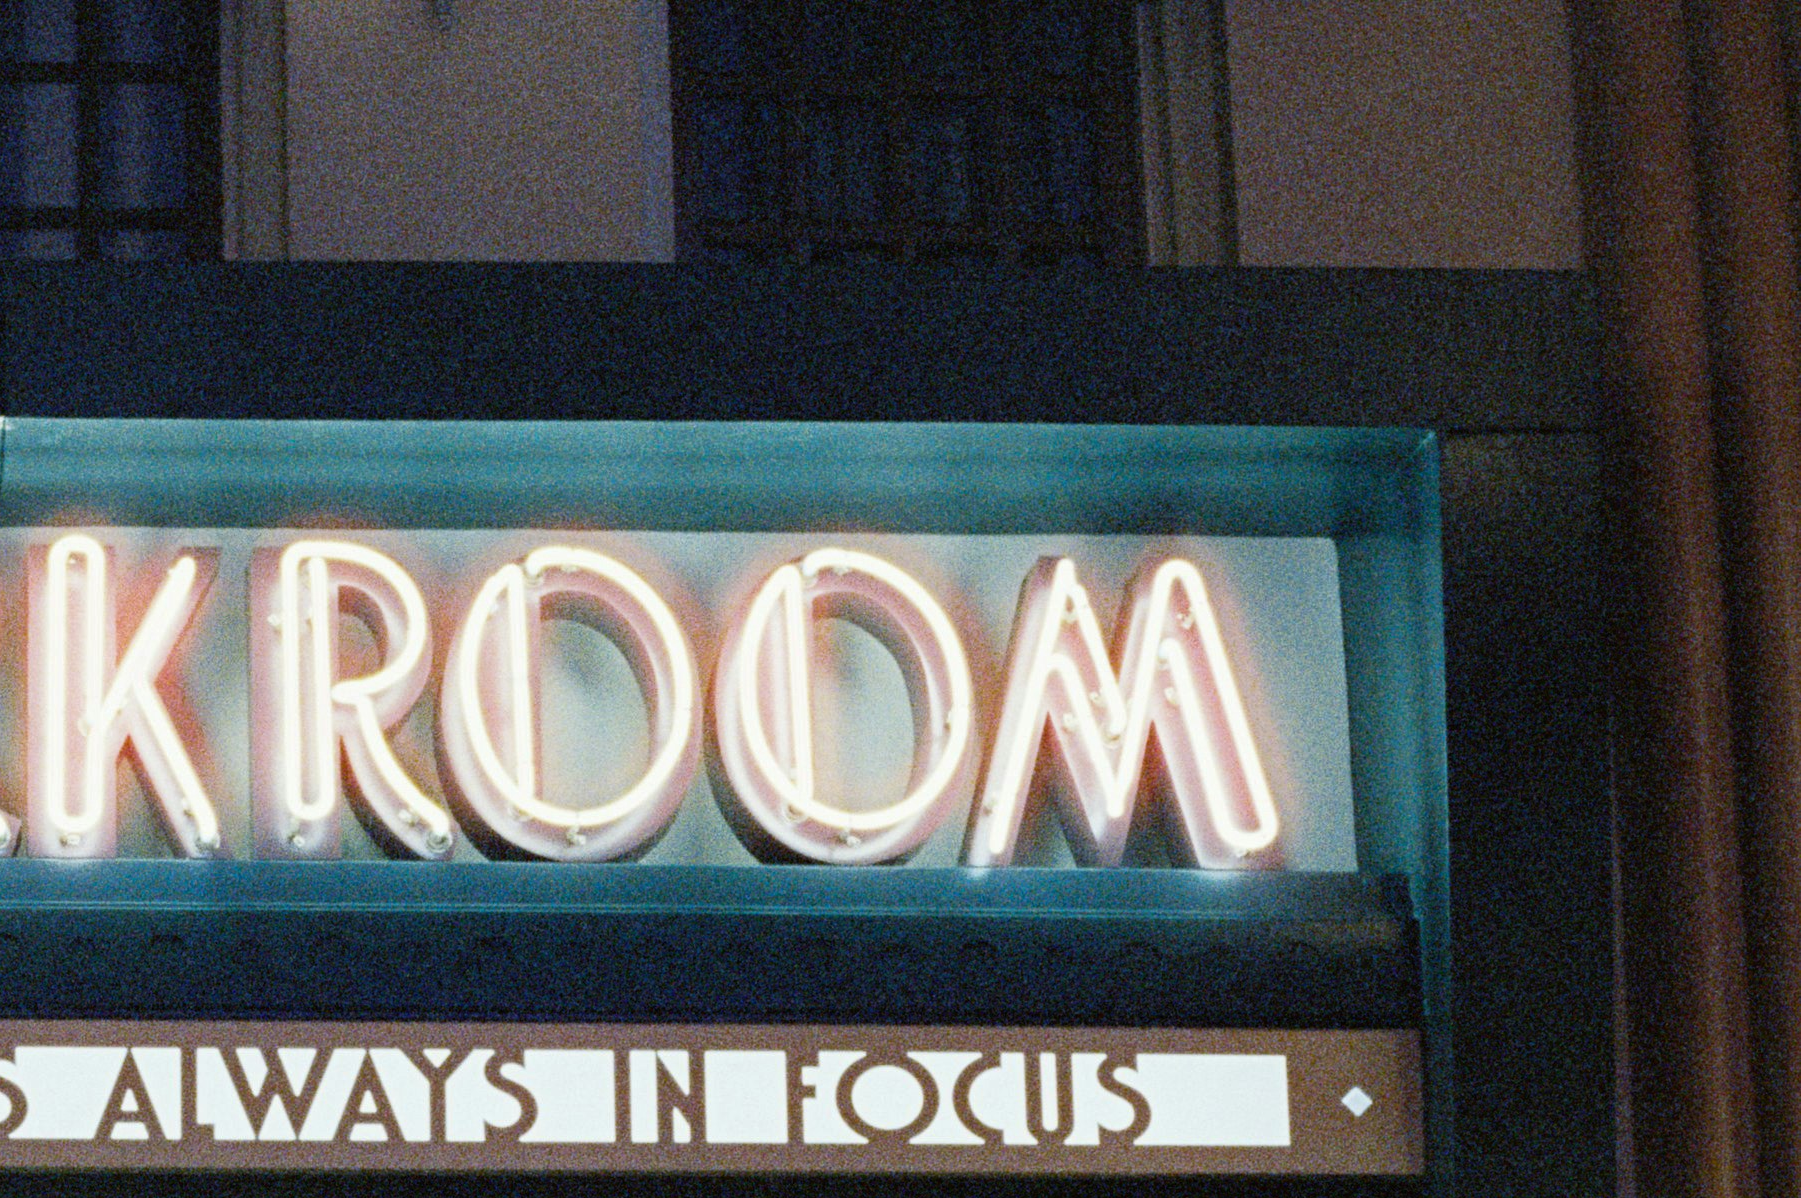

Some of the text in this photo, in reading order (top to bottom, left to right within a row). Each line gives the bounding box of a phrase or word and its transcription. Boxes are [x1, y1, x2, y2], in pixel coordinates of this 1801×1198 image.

[93, 1046, 537, 1143] ALWAYS
[613, 1049, 706, 1144] IN
[786, 1050, 1152, 1146] FOCUS
